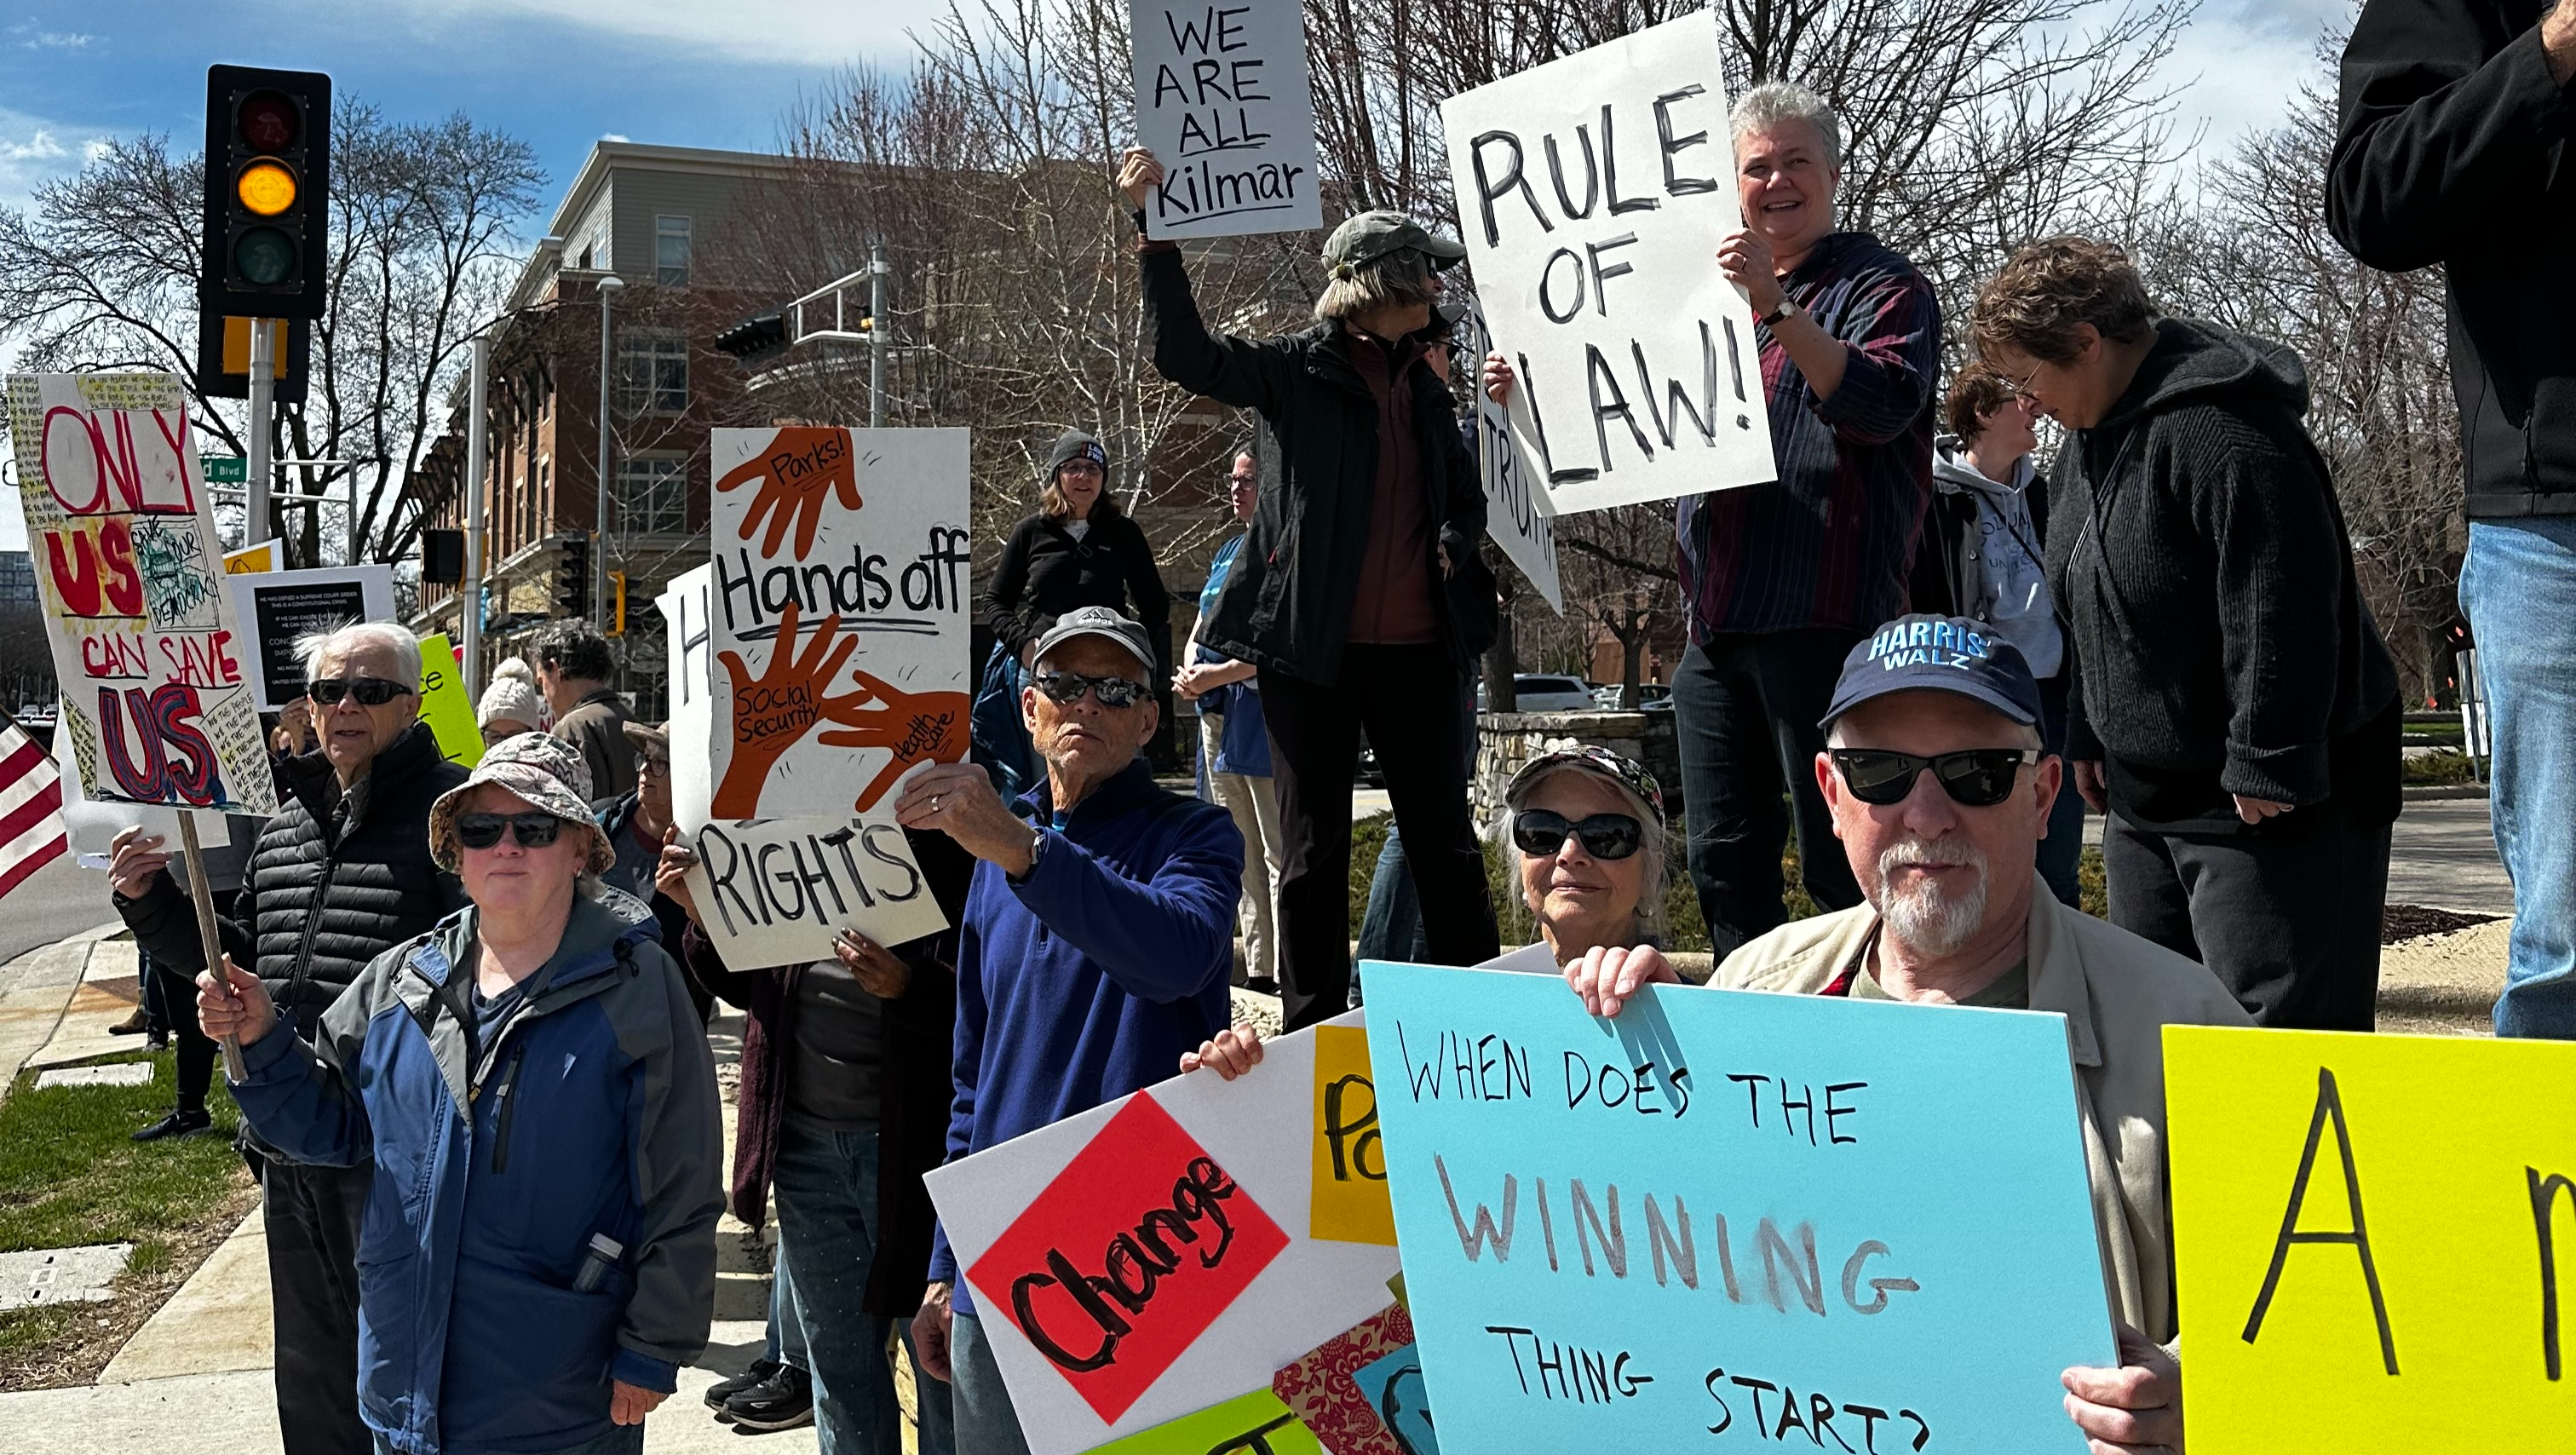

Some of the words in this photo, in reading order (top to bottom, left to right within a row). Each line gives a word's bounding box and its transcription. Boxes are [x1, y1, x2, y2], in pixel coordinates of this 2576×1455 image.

[1164, 6, 1251, 56] WE
[1155, 59, 1270, 108] ARE
[1179, 108, 1272, 153] ALL
[1470, 83, 1718, 249] RULE
[1538, 231, 1638, 325] OF
[1517, 314, 1751, 492] LAW!
[42, 401, 195, 514] ONLY
[203, 461, 212, 477] d
[219, 465, 239, 475] Blvd
[770, 430, 846, 486] Parks!
[130, 515, 164, 555] SAVE
[165, 532, 203, 562] OUR
[44, 521, 143, 617] US
[716, 543, 892, 630] Hands
[900, 526, 971, 613] off
[152, 571, 221, 626] DEMOCRACY
[83, 632, 149, 676] CAN
[159, 630, 243, 686] SAVE
[1867, 621, 1989, 661] HARRIS
[1883, 648, 1970, 670] WALZ
[736, 680, 812, 716] Social
[894, 713, 936, 763] Health
[1397, 1021, 1532, 1104] WHEN
[1563, 1050, 1689, 1119] DOES
[1725, 1073, 1868, 1147] THE
[1435, 1152, 1921, 1318] WINNING
[1010, 1156, 1238, 1372] Change
[1485, 1326, 1655, 1404] THING
[1706, 1367, 1930, 1455] START?
